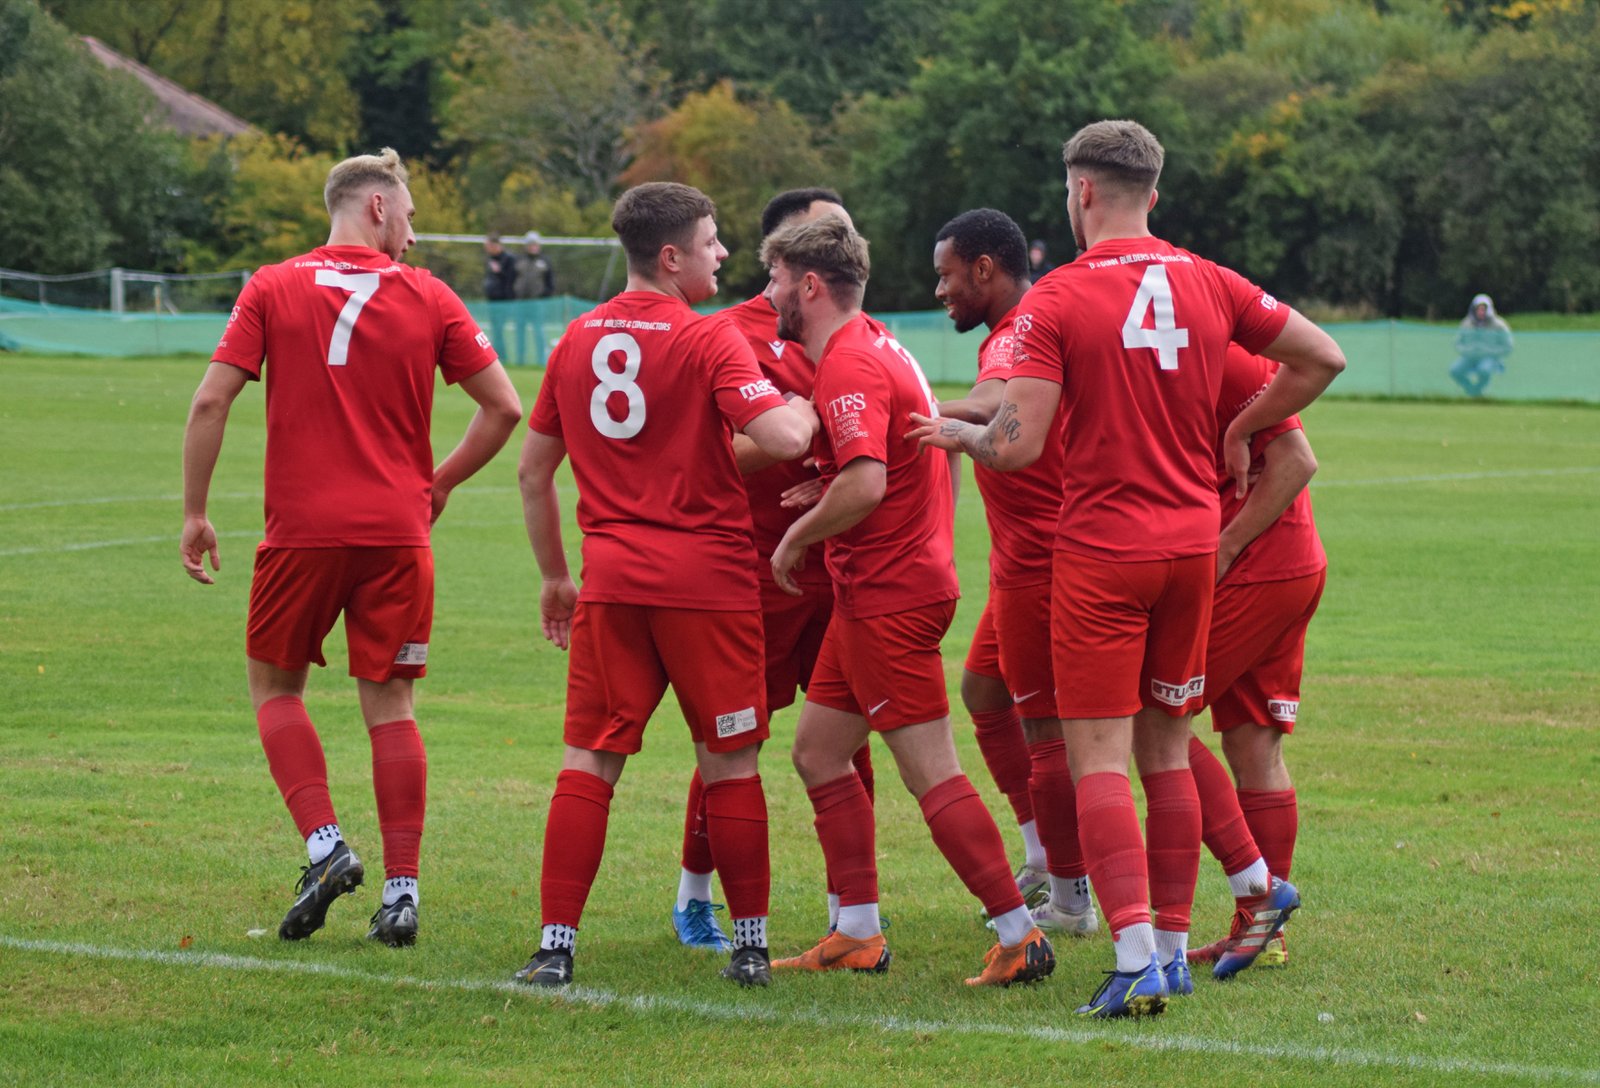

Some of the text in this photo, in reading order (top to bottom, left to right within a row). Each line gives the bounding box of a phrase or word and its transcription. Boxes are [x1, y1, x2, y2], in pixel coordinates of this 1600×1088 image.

[1119, 253, 1150, 265] BUILDERS
[315, 269, 380, 366] 7
[1122, 264, 1189, 370] 4
[590, 332, 647, 440] 8
[828, 392, 867, 418] TFS
[834, 411, 861, 424] THOMAS
